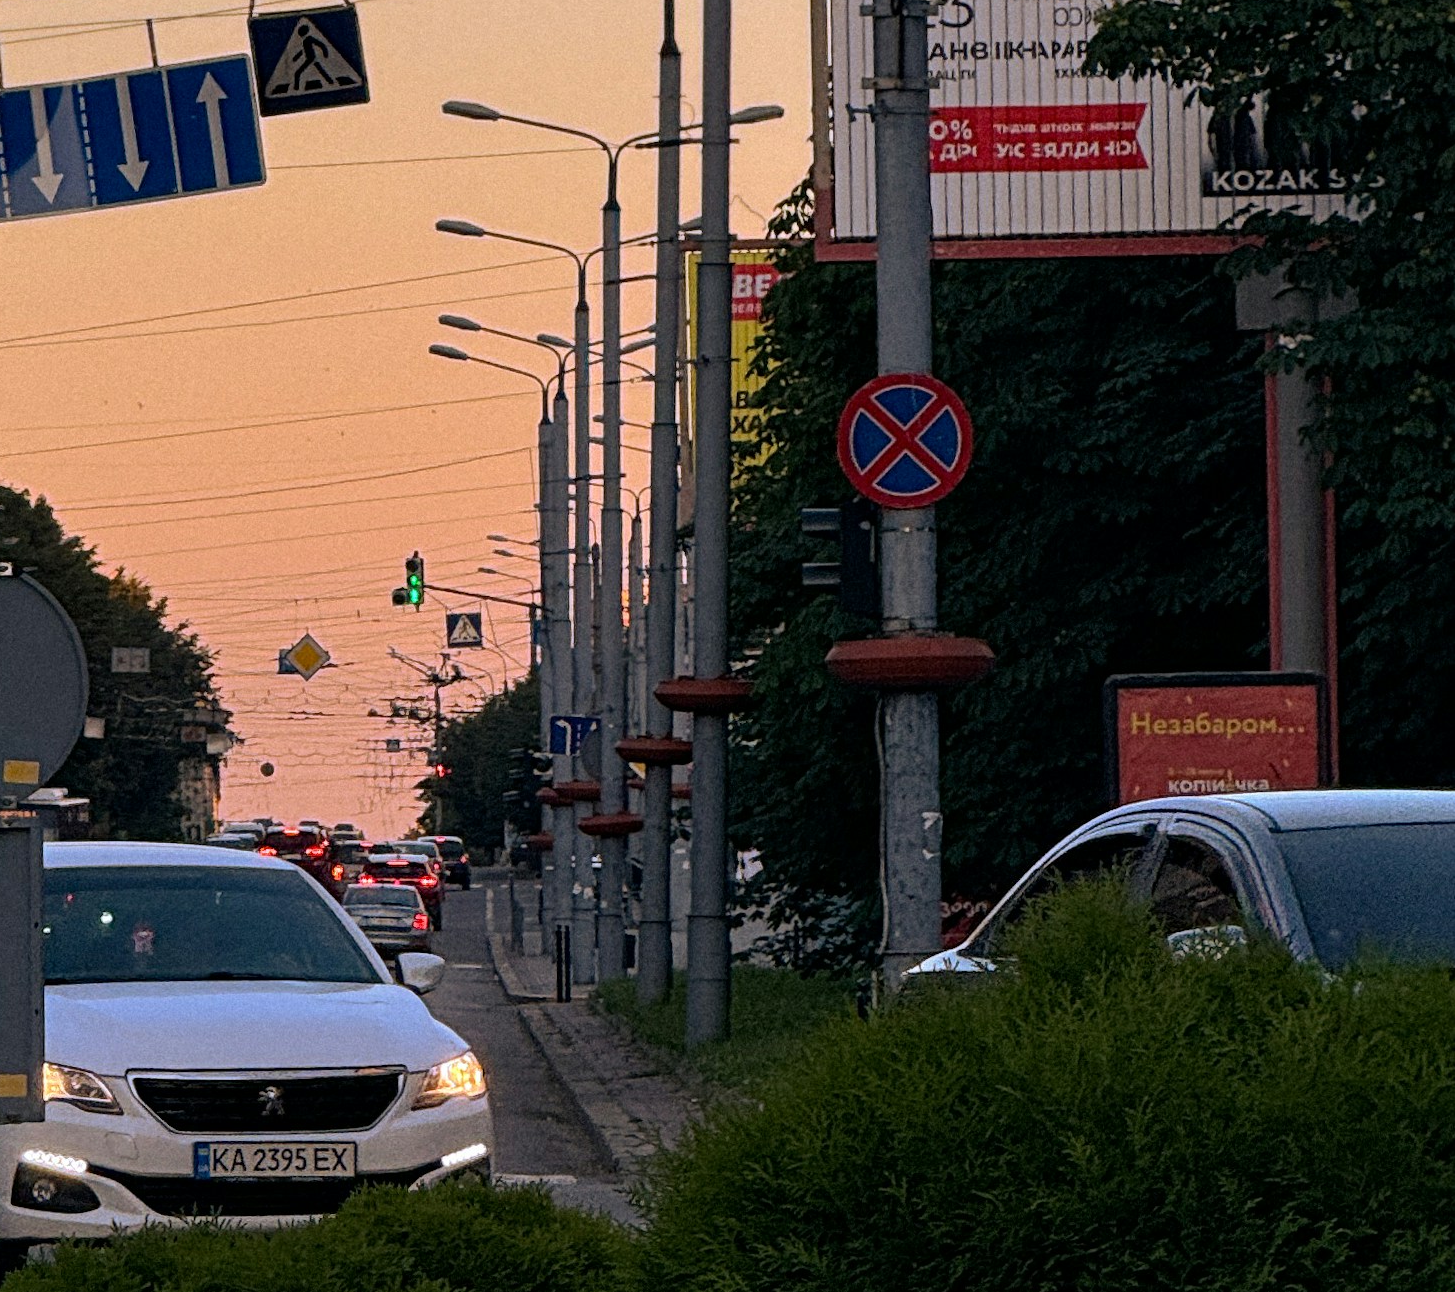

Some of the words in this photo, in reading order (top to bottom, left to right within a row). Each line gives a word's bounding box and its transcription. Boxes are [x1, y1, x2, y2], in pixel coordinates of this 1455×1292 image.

[1211, 168, 1320, 192] KOZAK
[212, 1148, 247, 1172] KA
[253, 1147, 308, 1172] 2395
[313, 1147, 348, 1171] EX
